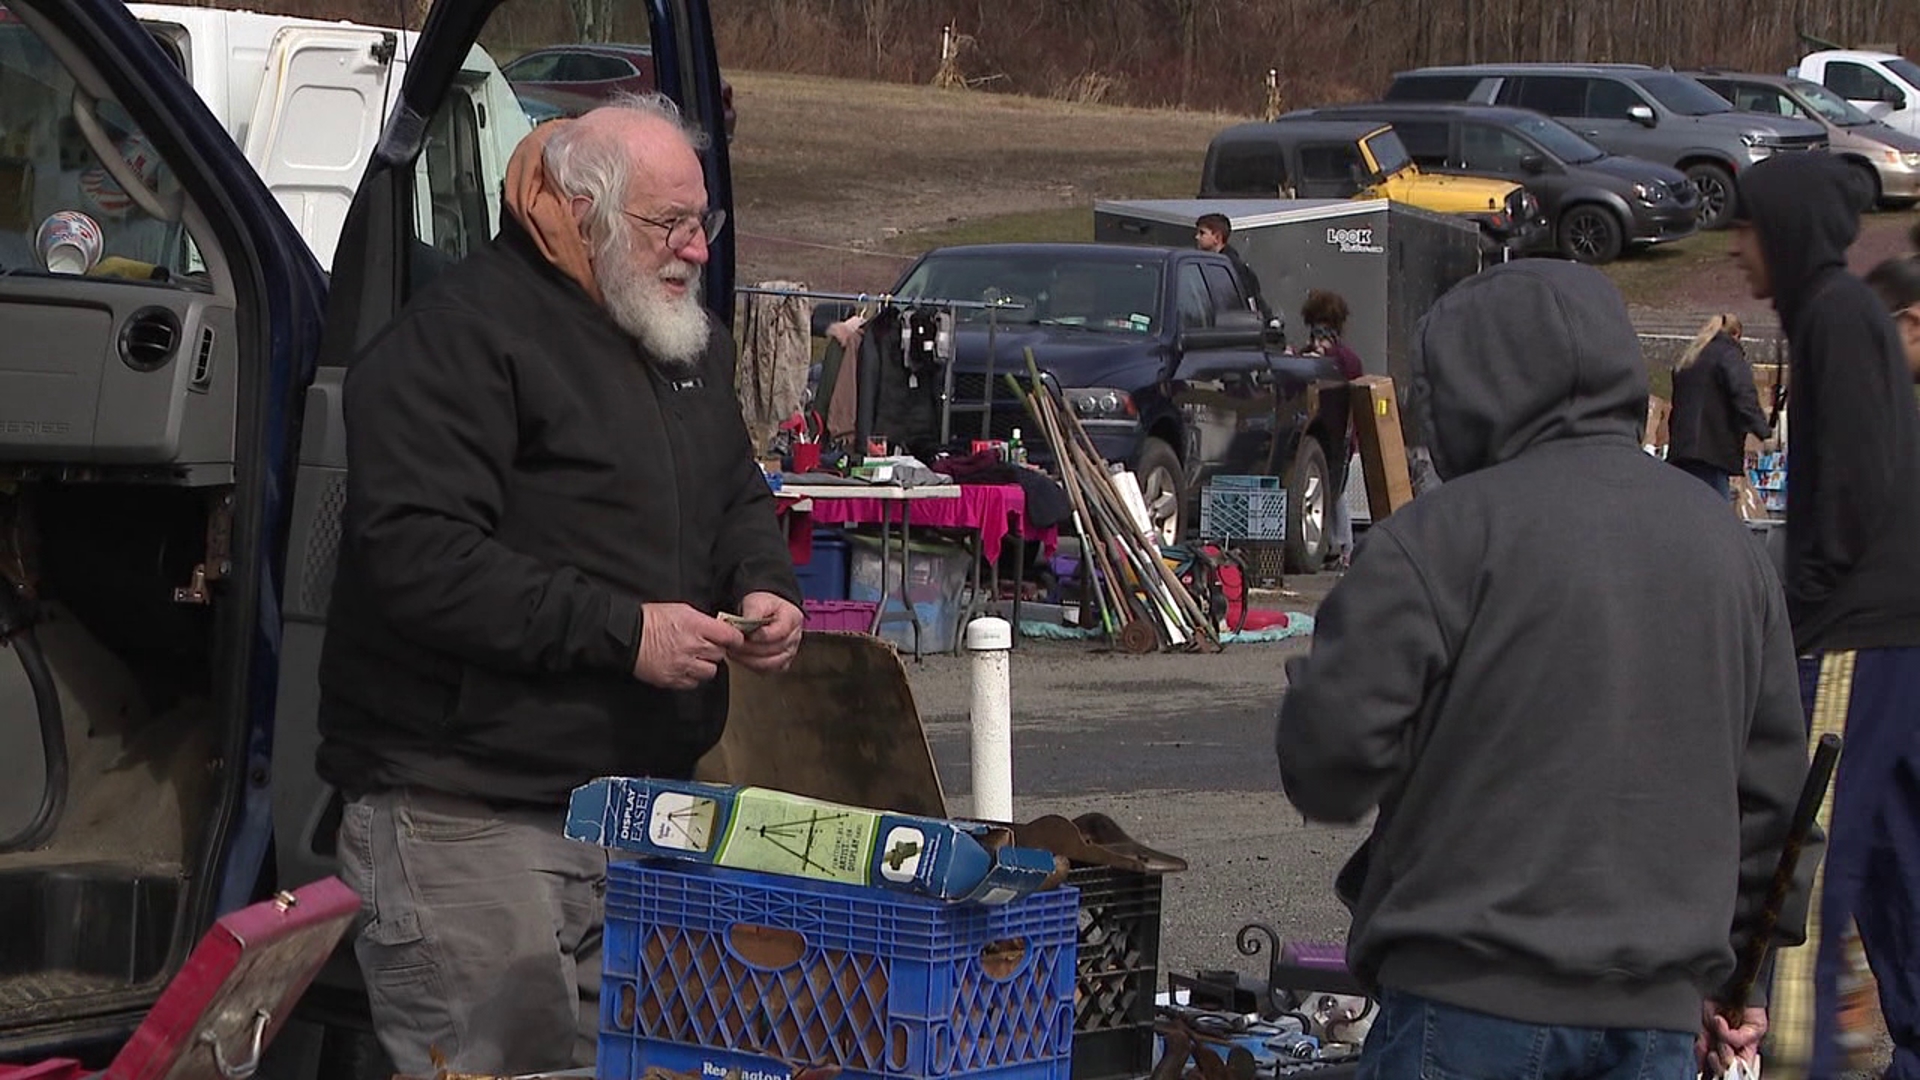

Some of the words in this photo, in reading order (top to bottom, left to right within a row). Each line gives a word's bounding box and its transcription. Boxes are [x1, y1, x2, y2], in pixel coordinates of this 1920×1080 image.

[1326, 227, 1372, 244] LOOK
[620, 788, 636, 840] DISPLAY
[630, 790, 650, 843] EASEL
